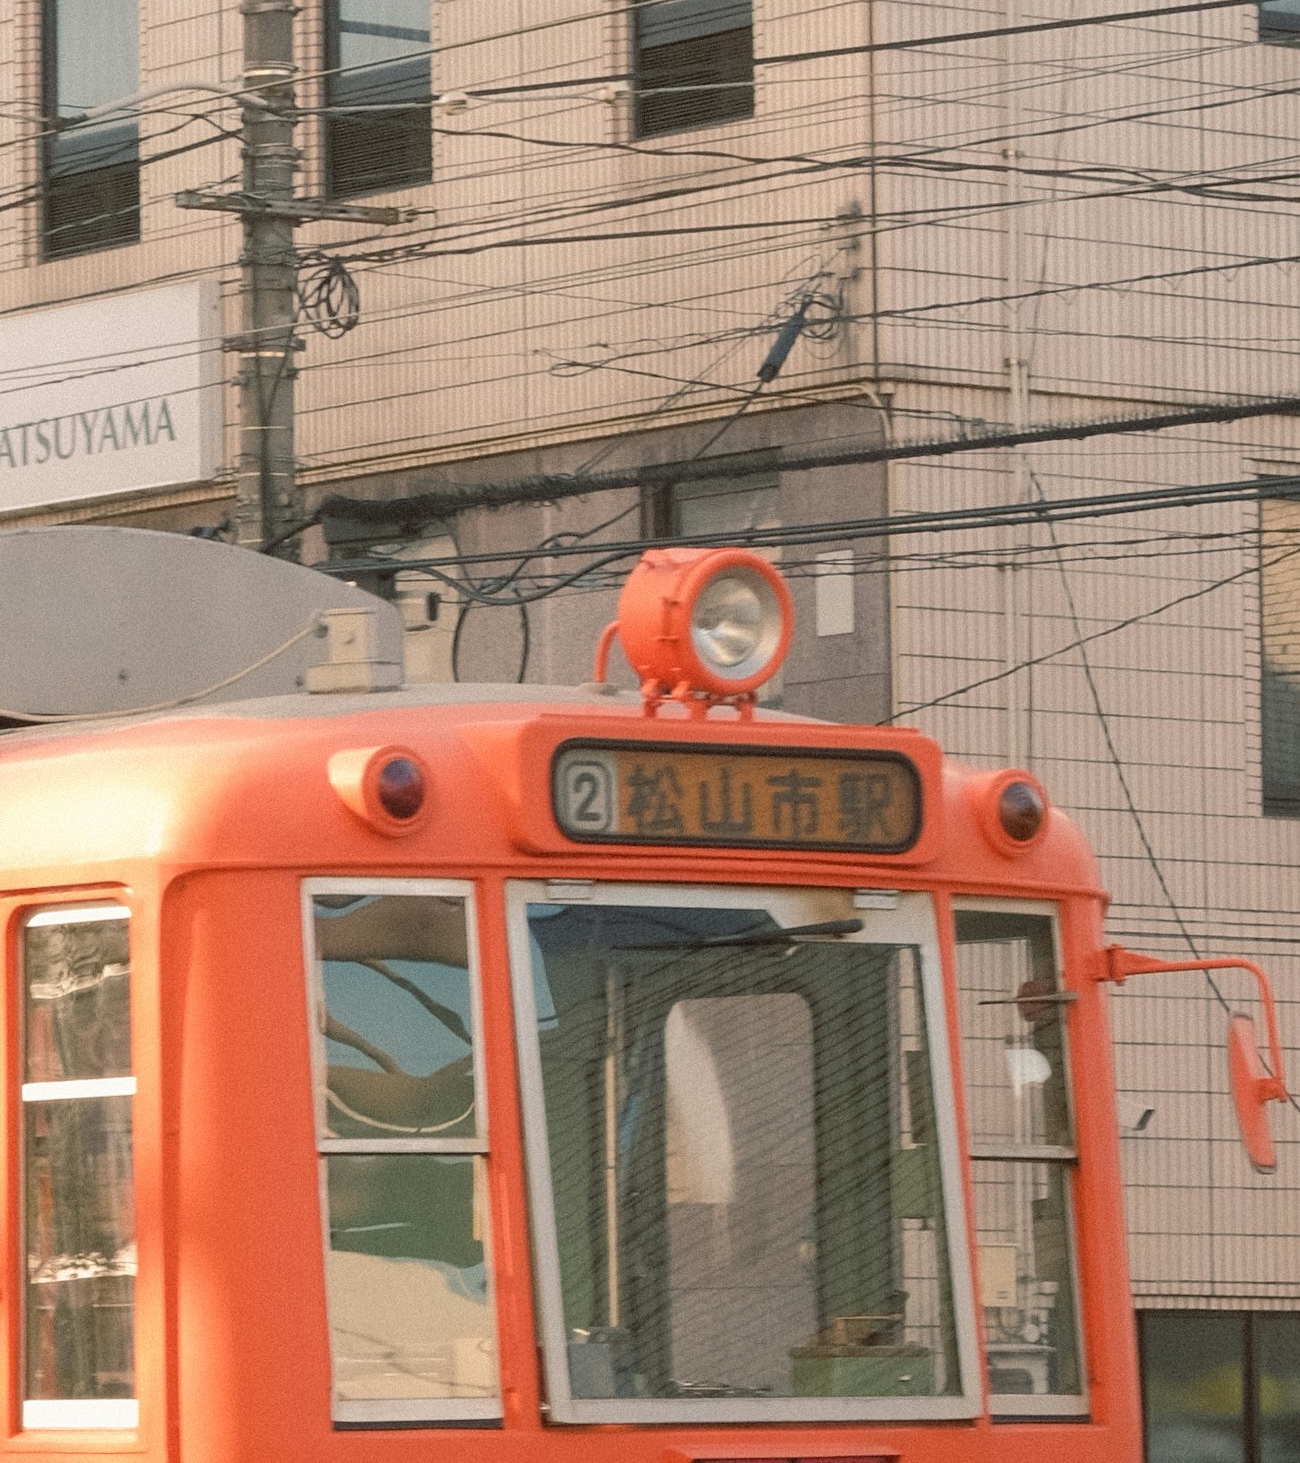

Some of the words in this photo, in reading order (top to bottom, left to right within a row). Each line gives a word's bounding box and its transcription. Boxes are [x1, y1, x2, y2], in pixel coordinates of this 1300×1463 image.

[572, 771, 600, 822] 2
[625, 763, 895, 841] 松山市駅
